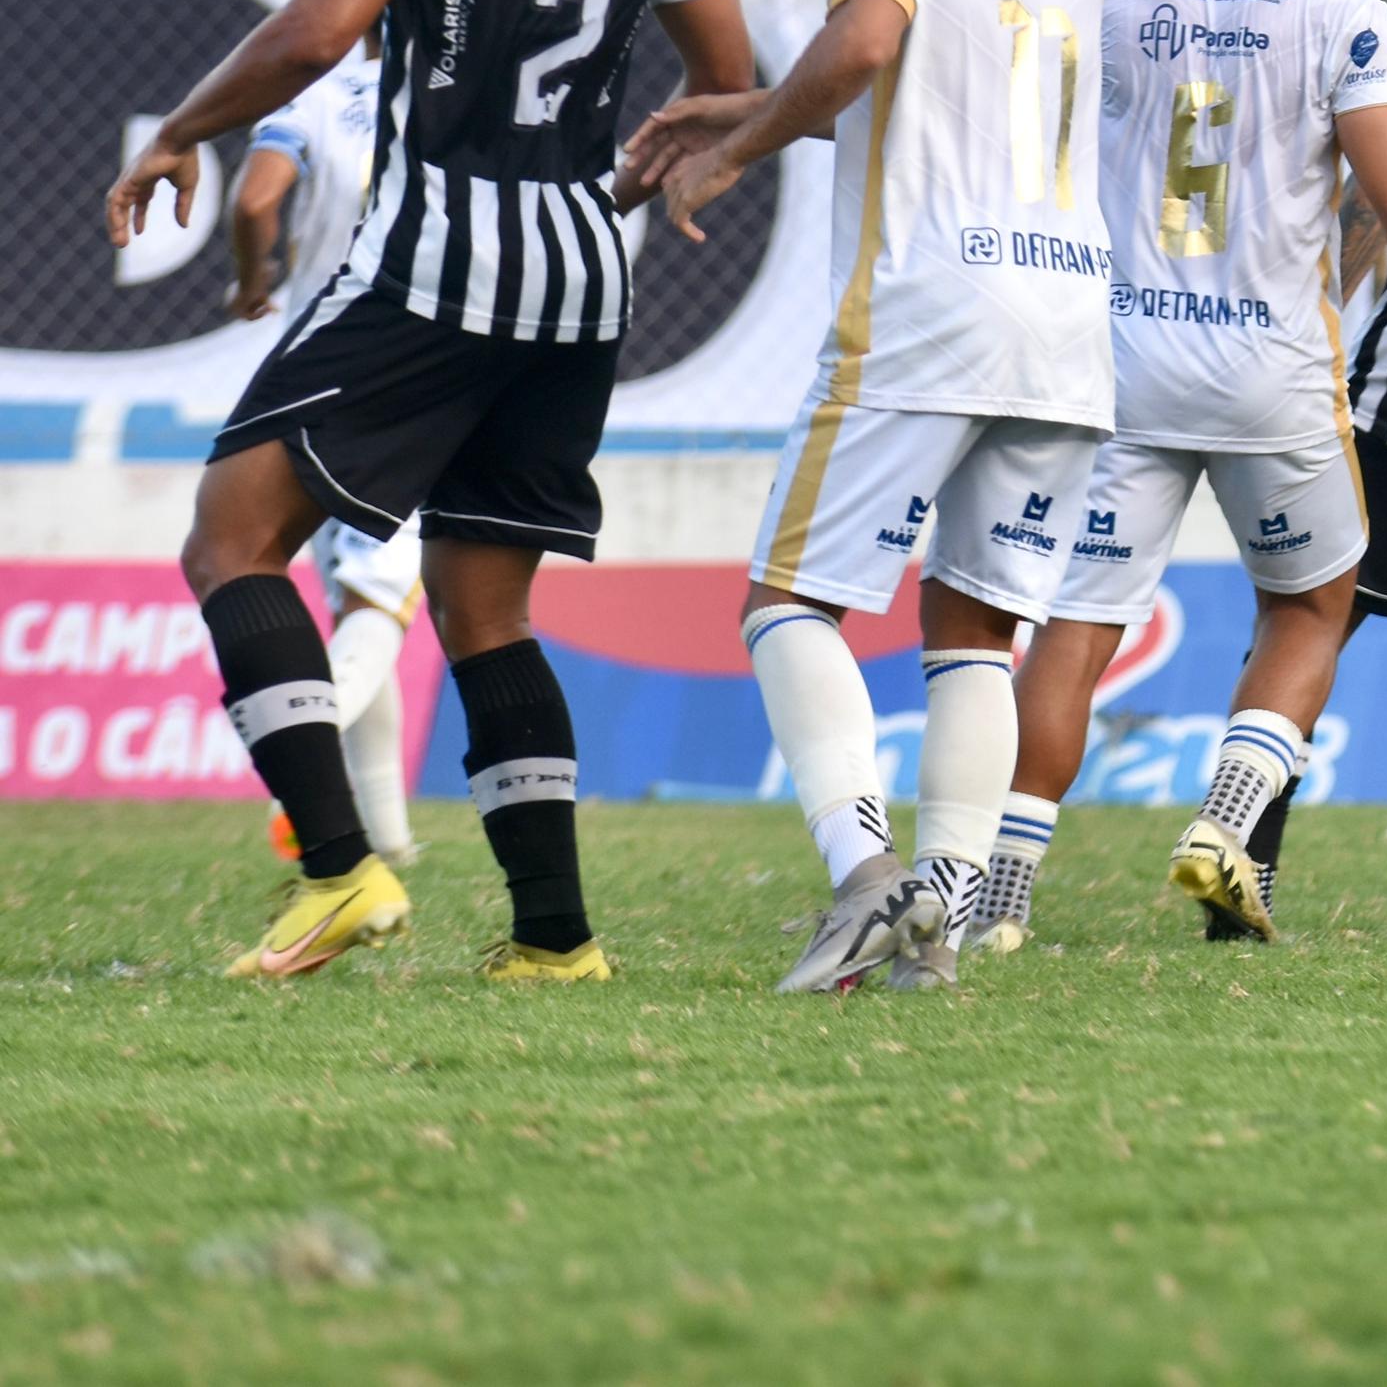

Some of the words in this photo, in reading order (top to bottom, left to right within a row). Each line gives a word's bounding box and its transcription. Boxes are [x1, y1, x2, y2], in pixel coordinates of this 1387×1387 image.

[1158, 80, 1235, 258] 6
[1142, 287, 1271, 328] DETRAN-PB
[991, 522, 1057, 552] MARTINS
[4, 603, 222, 675] CAMP
[100, 695, 258, 780] CÂN
